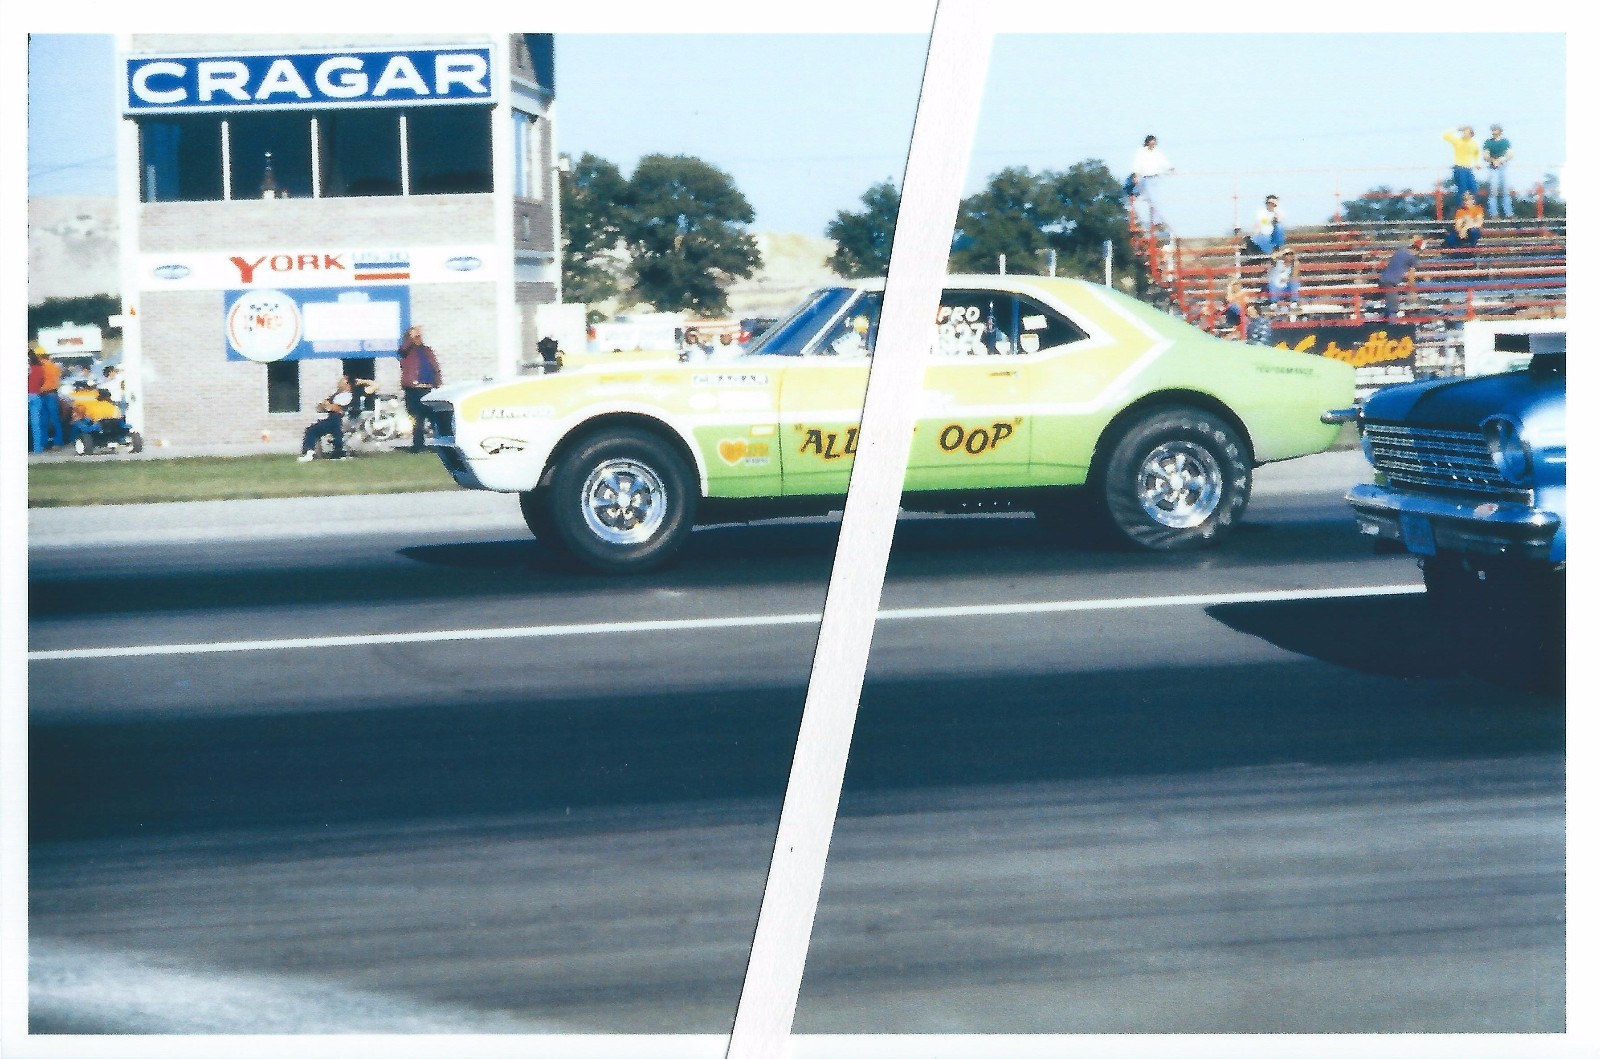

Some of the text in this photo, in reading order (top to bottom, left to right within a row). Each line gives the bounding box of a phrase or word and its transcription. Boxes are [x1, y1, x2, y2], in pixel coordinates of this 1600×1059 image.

[130, 52, 489, 104] CRAGAR
[227, 253, 346, 284] YORK
[937, 305, 981, 322] PRO
